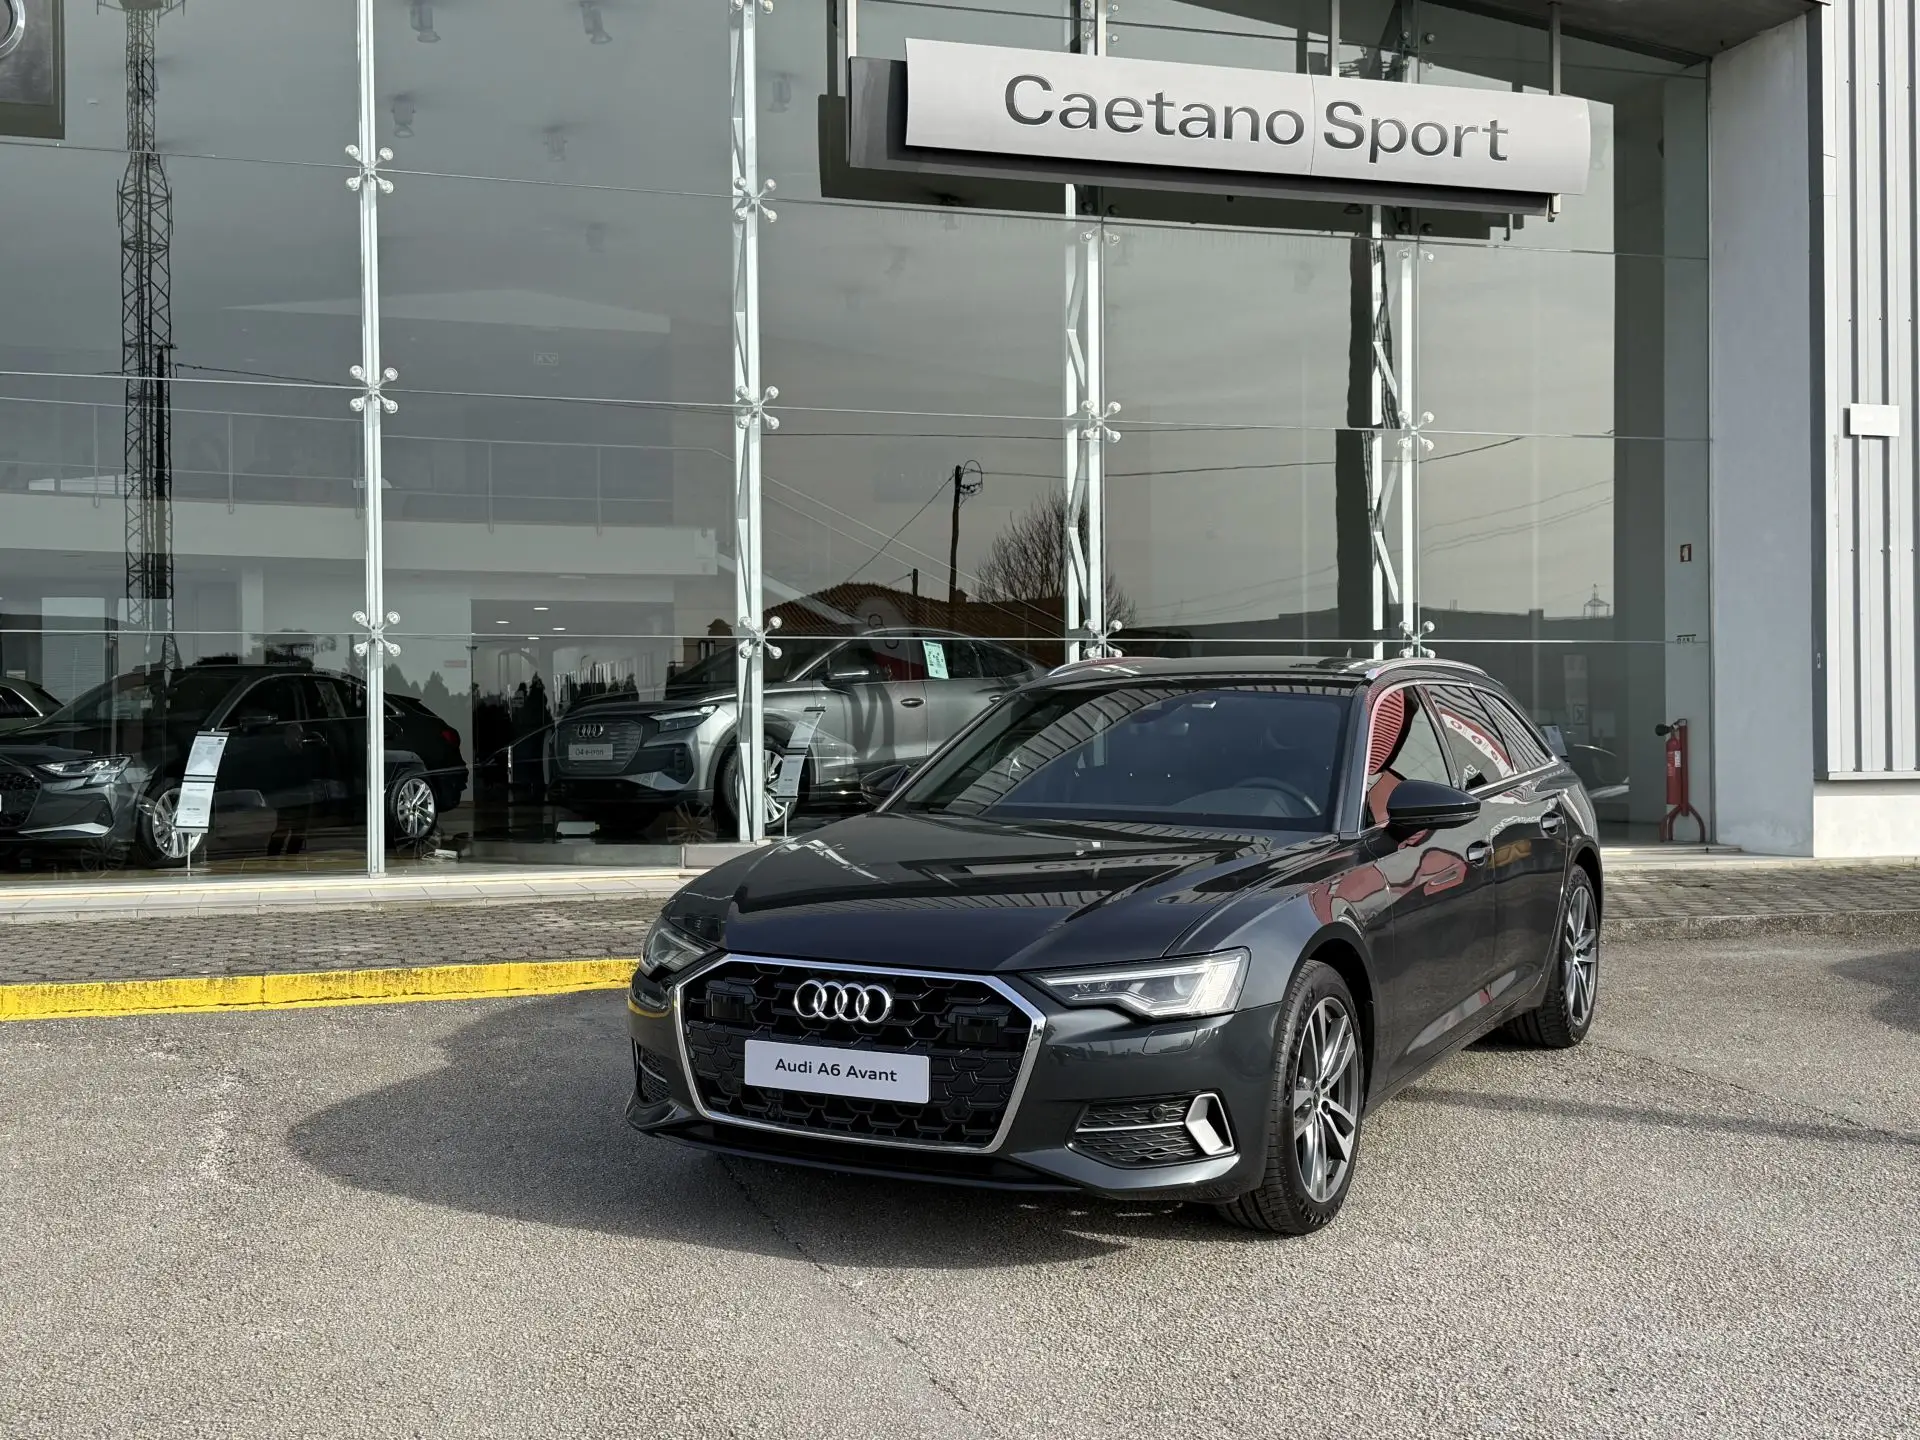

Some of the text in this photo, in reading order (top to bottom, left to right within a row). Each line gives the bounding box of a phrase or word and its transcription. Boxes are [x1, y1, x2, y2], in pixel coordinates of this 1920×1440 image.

[1004, 73, 1509, 164] Caetano Sport
[775, 1058, 898, 1082] Audi A6 Avant
